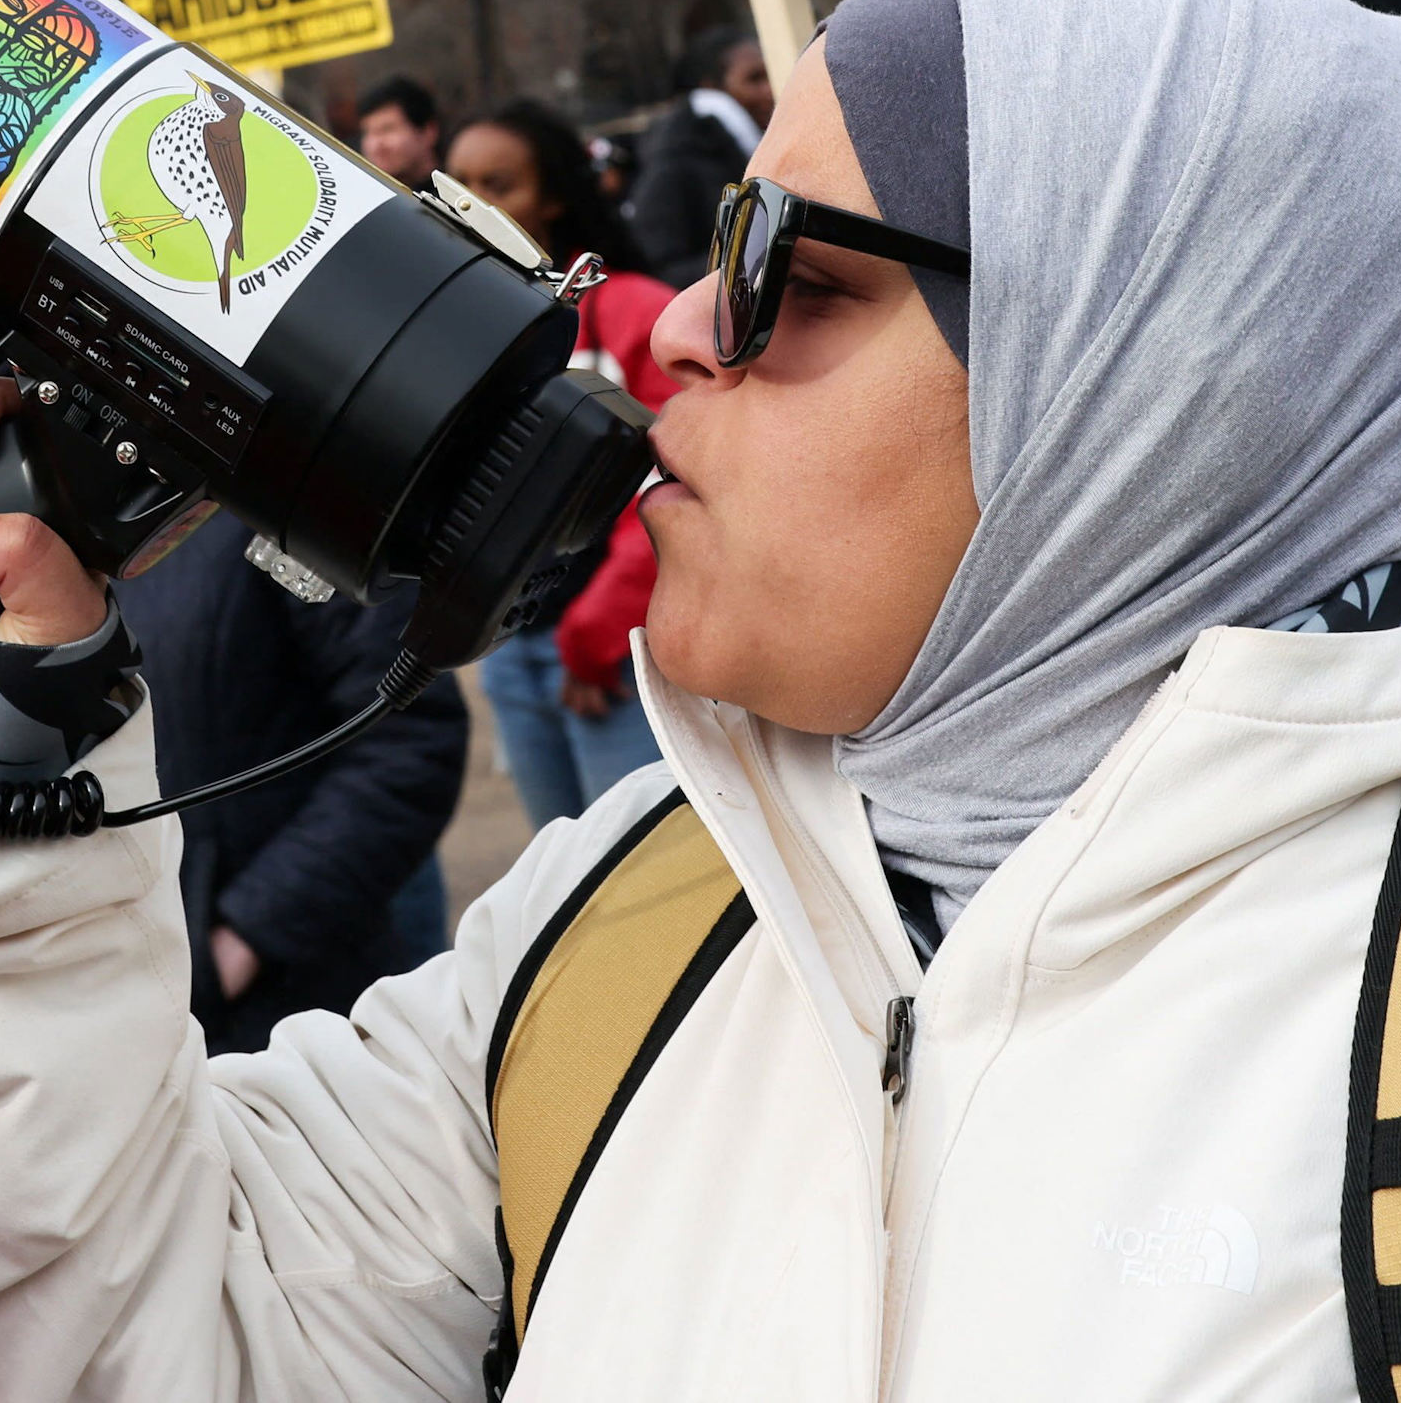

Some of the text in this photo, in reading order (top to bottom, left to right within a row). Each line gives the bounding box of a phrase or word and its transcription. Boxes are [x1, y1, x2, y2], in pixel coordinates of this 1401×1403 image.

[237, 105, 338, 296] MIGRANT SOLIDARITY MUTUAL AID
[48, 274, 66, 292] USB
[37, 293, 58, 315] BT
[55, 325, 82, 349] MODE
[123, 322, 191, 374] SD/MMC CARD
[70, 382, 129, 431] ON OFF
[220, 404, 242, 425] AUX
[215, 417, 236, 437] LED
